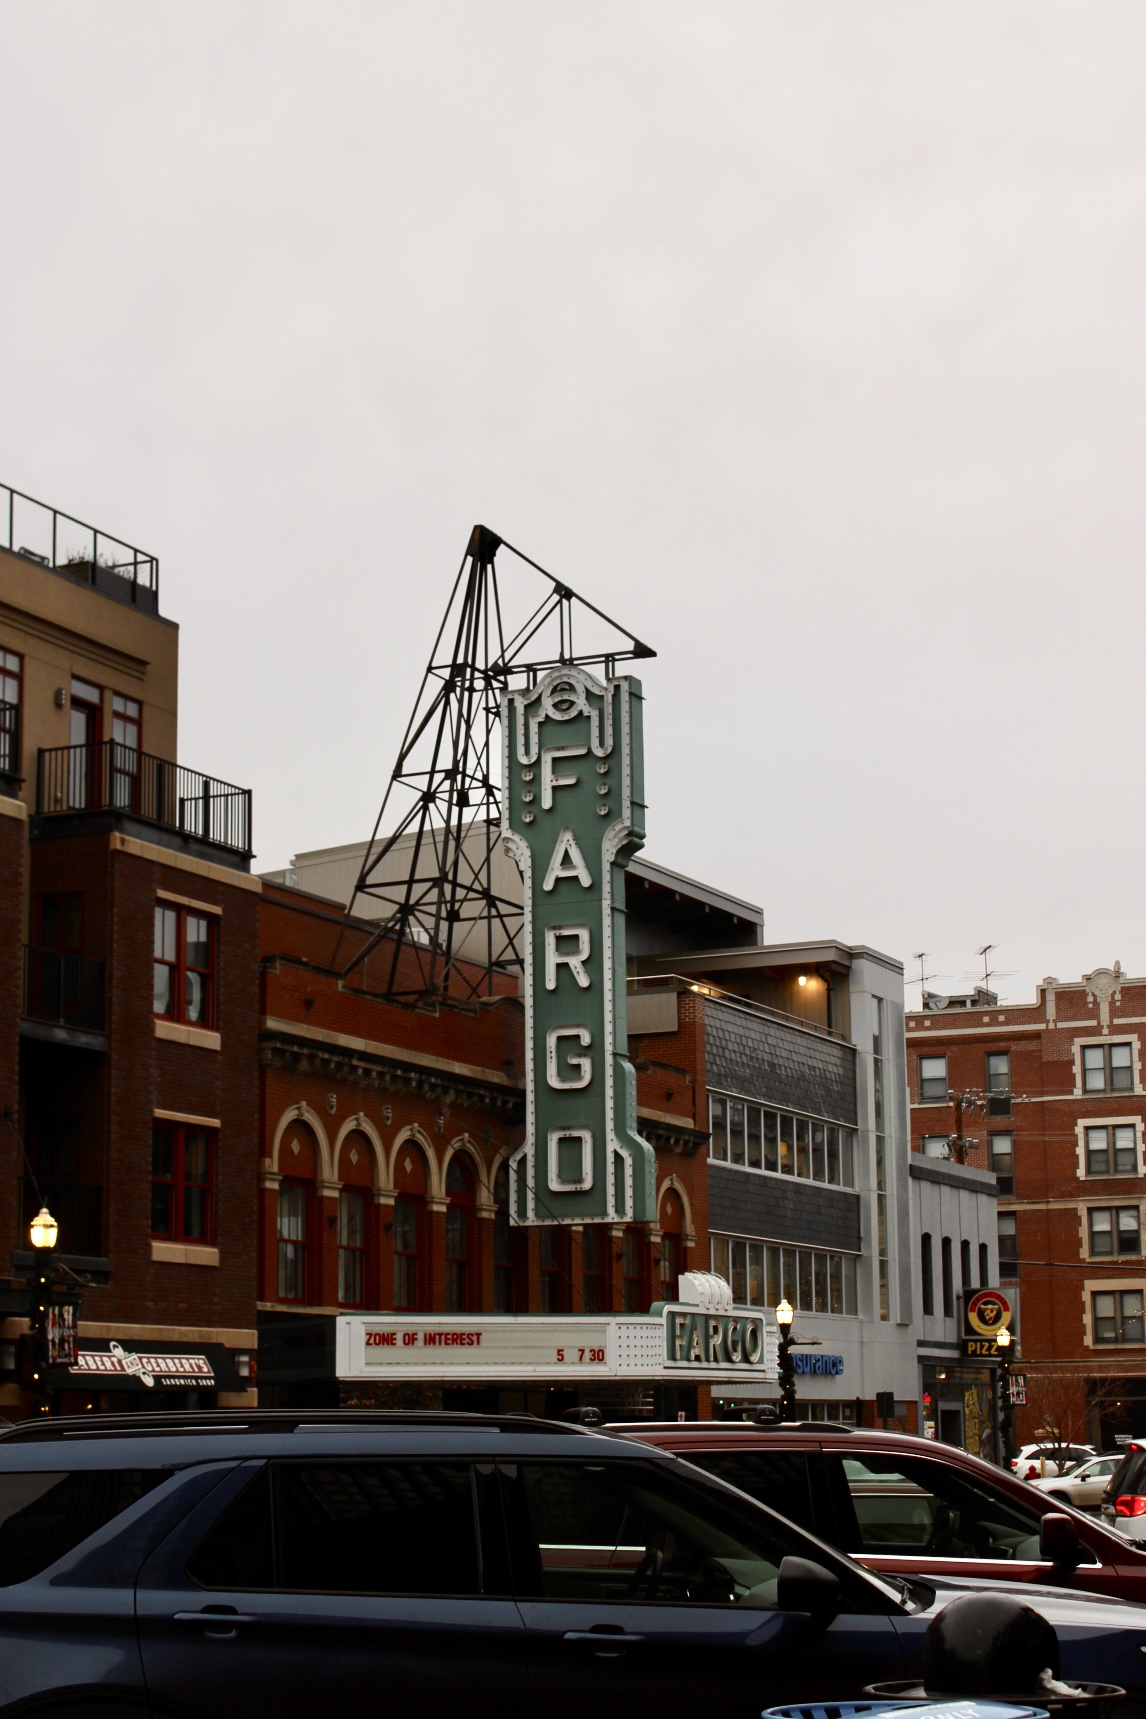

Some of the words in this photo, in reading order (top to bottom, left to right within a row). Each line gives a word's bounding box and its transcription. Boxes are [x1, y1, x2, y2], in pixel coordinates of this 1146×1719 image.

[542, 744, 593, 1192] FARGO
[365, 1332, 397, 1346] ZONE
[402, 1332, 418, 1346] OF
[423, 1332, 482, 1347] INTEREST
[675, 1314, 762, 1363] FARGO
[556, 1348, 564, 1362] 5
[967, 1341, 999, 1355] PIZZ
[125, 1357, 140, 1369] AND
[142, 1357, 209, 1372] GERBERT'S
[791, 1353, 844, 1375] nsurance
[161, 1378, 197, 1386] SANDWICH
[198, 1379, 215, 1387] SHOP
